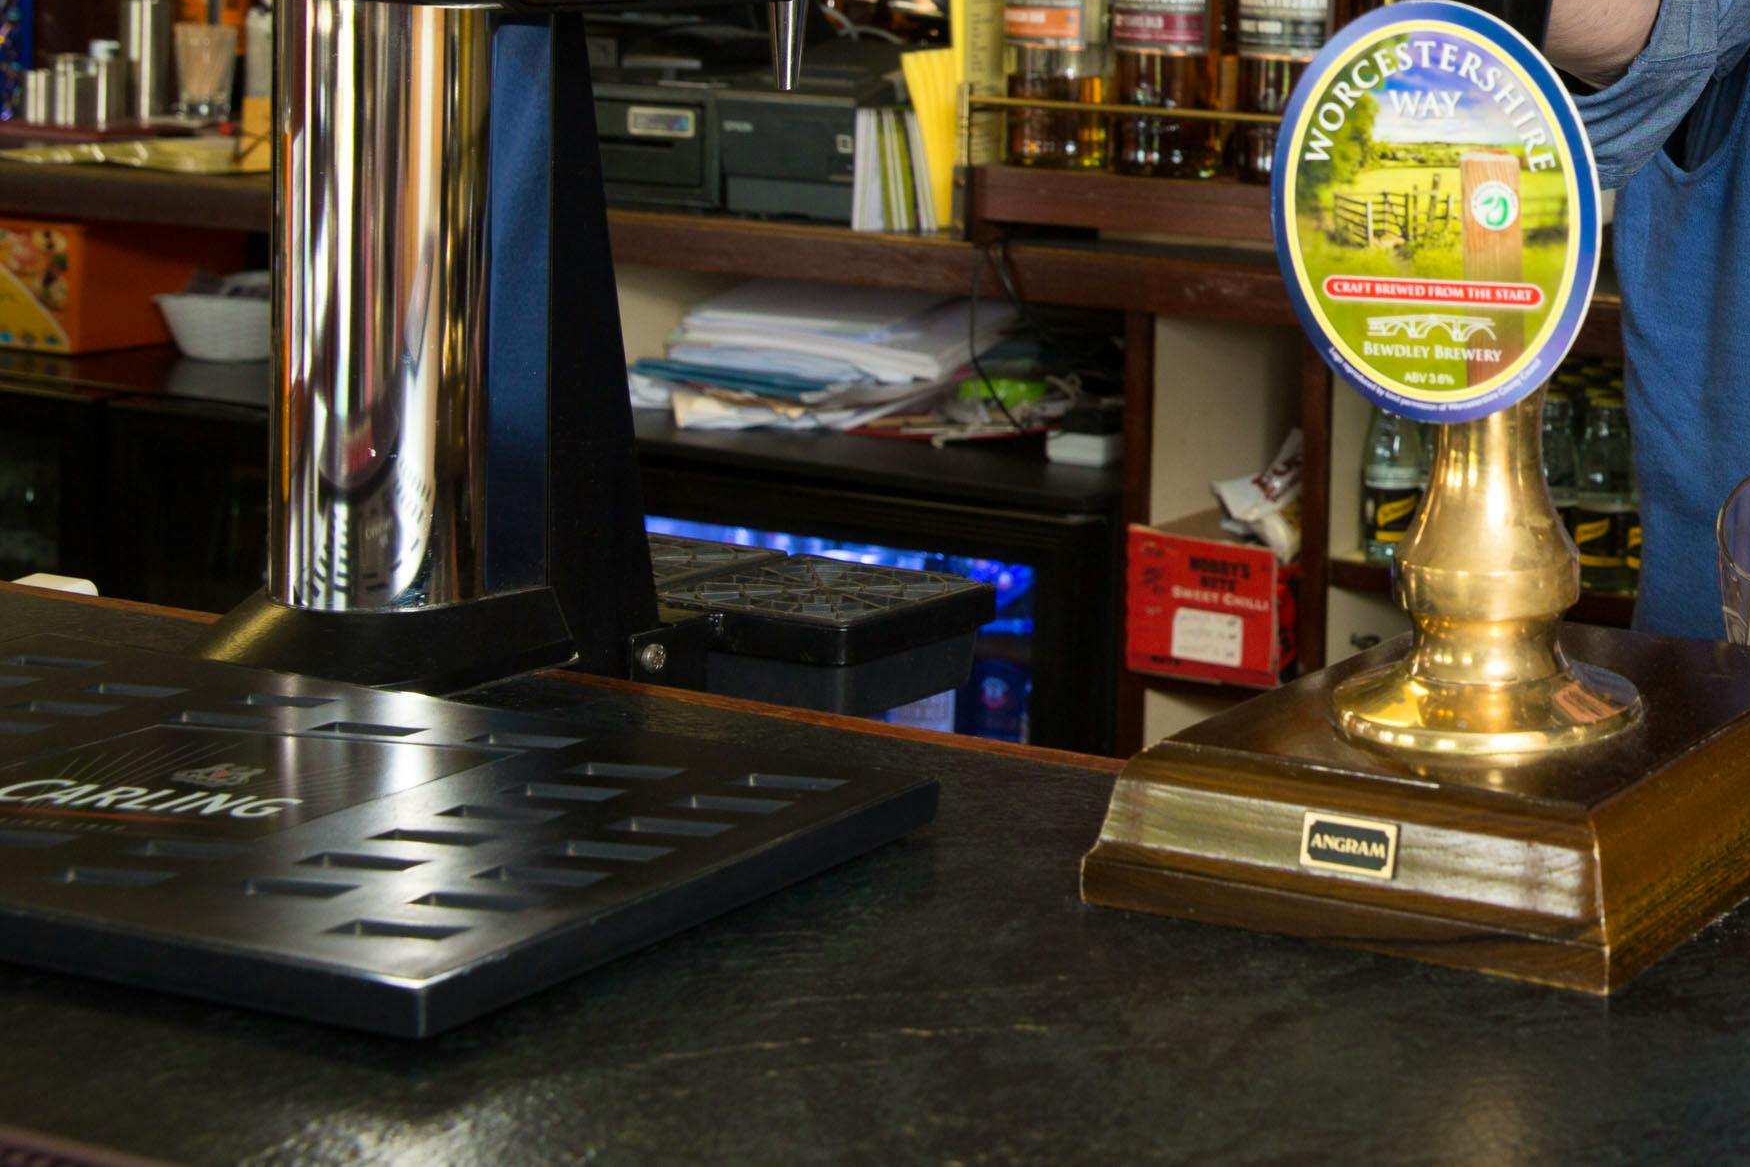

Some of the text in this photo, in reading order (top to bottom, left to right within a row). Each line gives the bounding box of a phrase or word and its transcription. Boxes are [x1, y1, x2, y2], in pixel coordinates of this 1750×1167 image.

[1303, 39, 1558, 175] WORCESTERSHIRE
[1388, 89, 1465, 119] WAY
[1332, 281, 1535, 302] CRAFT BREWED FROM THE START
[1362, 340, 1503, 363] BEWDLEY BREWERY
[1404, 371, 1428, 384] ABV
[1171, 585, 1270, 612] SWEET CHILLI
[0, 778, 304, 819] CARLING
[1310, 832, 1386, 859] ANGRAM
